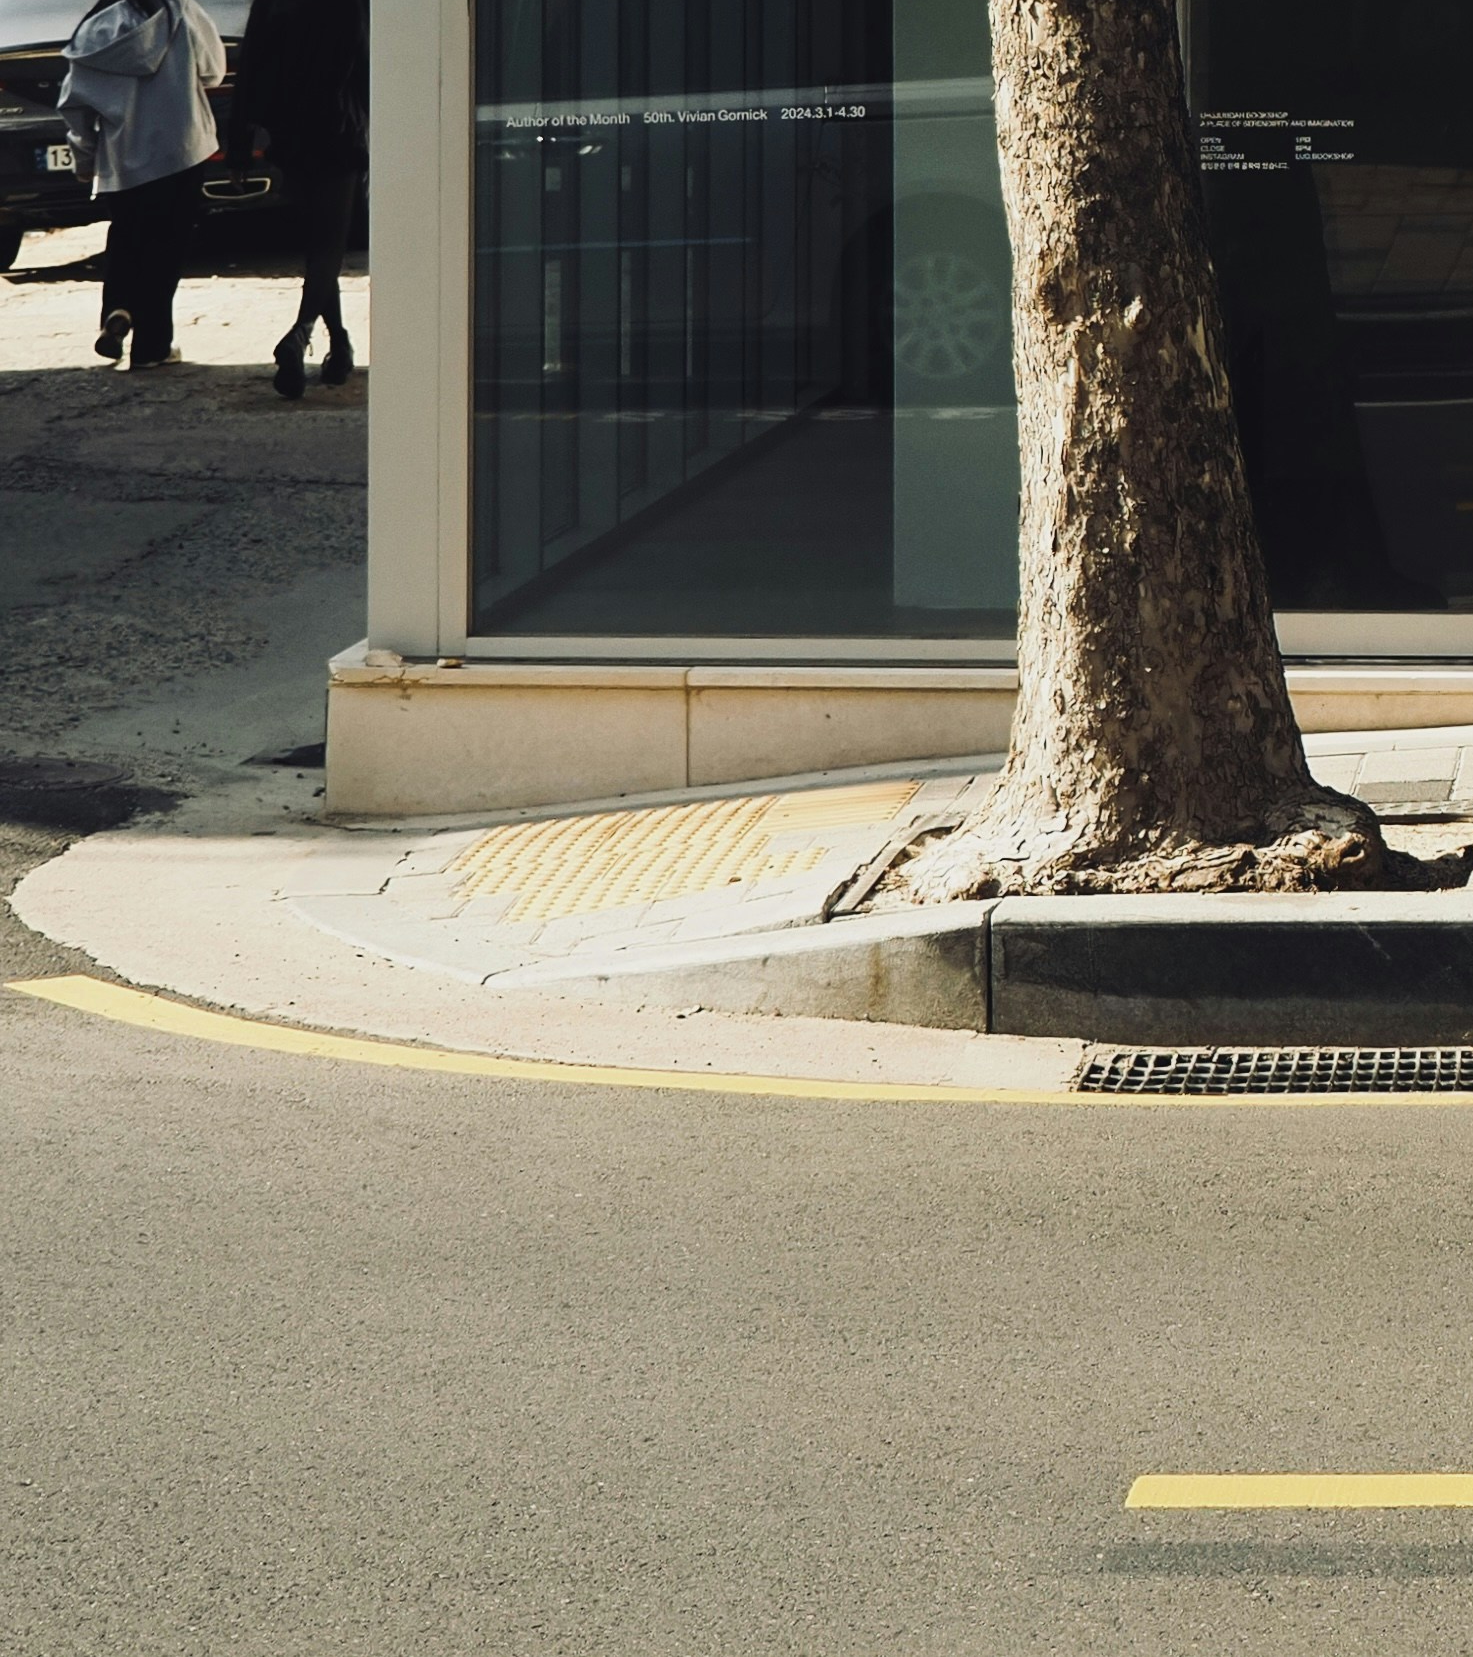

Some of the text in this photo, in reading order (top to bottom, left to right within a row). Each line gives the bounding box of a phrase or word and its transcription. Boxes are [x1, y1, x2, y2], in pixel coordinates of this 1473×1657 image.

[506, 106, 866, 128] Author of the Month 50th. Vivian Gornick 2024.3.1-4.30
[1200, 136, 1221, 144] OPEN
